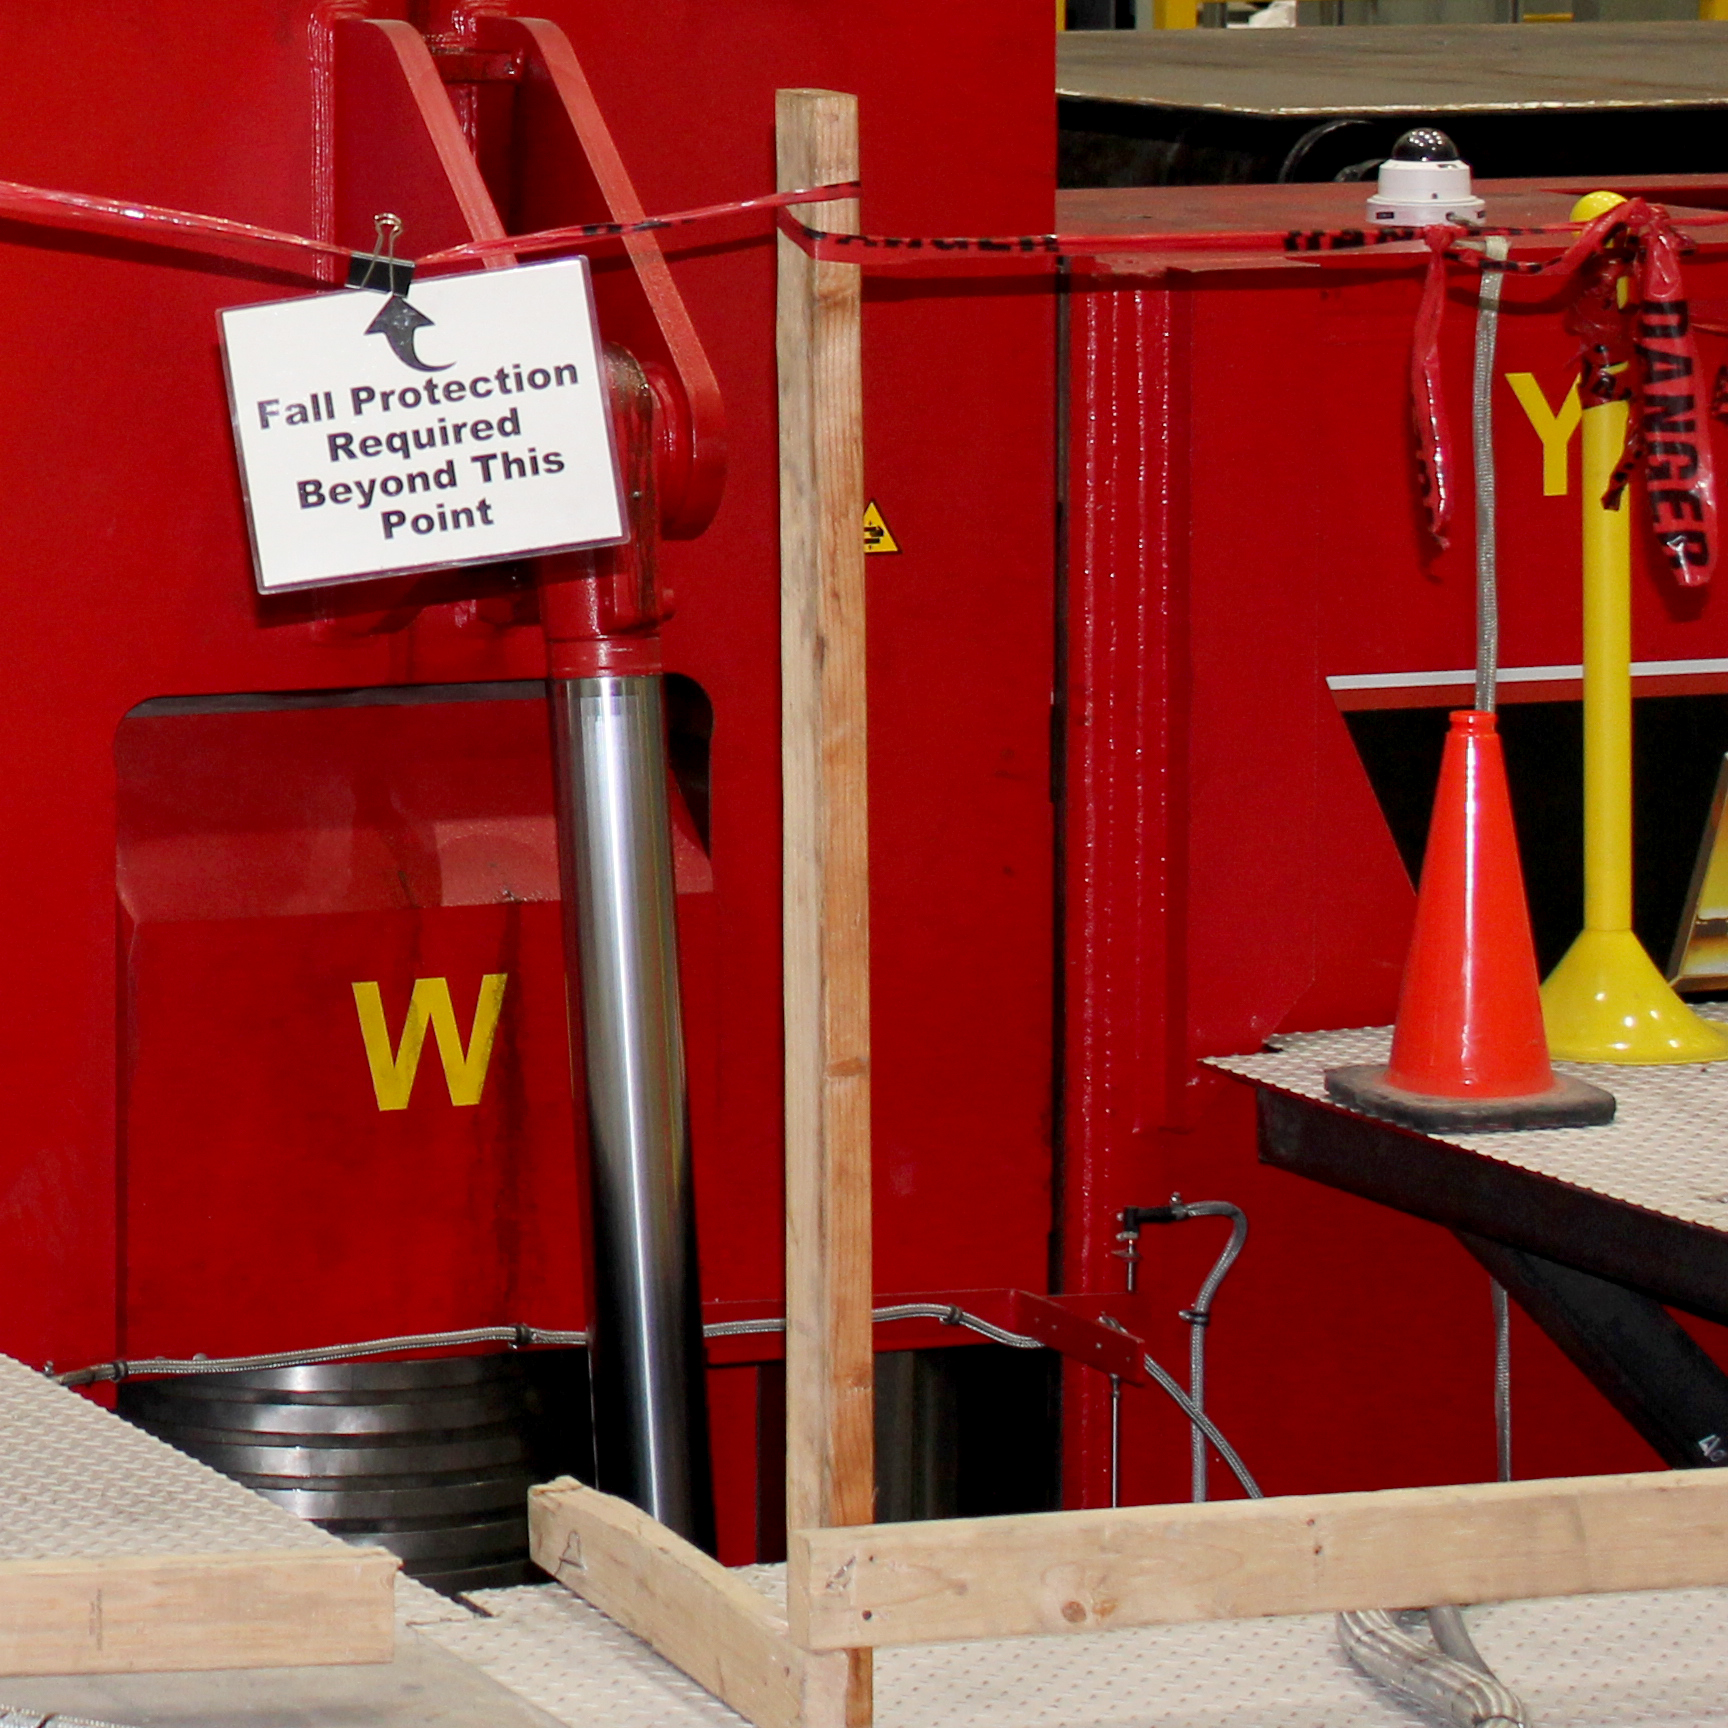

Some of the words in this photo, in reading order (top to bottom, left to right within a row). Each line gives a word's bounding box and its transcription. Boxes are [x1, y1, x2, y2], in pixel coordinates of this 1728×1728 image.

[256, 391, 336, 430] Fall
[349, 362, 580, 416] Protection
[326, 406, 523, 462] Required
[1505, 372, 1583, 497] Y
[296, 459, 459, 510] Beyond
[470, 446, 566, 484] This
[380, 497, 495, 540] Point
[351, 974, 507, 1111] W
